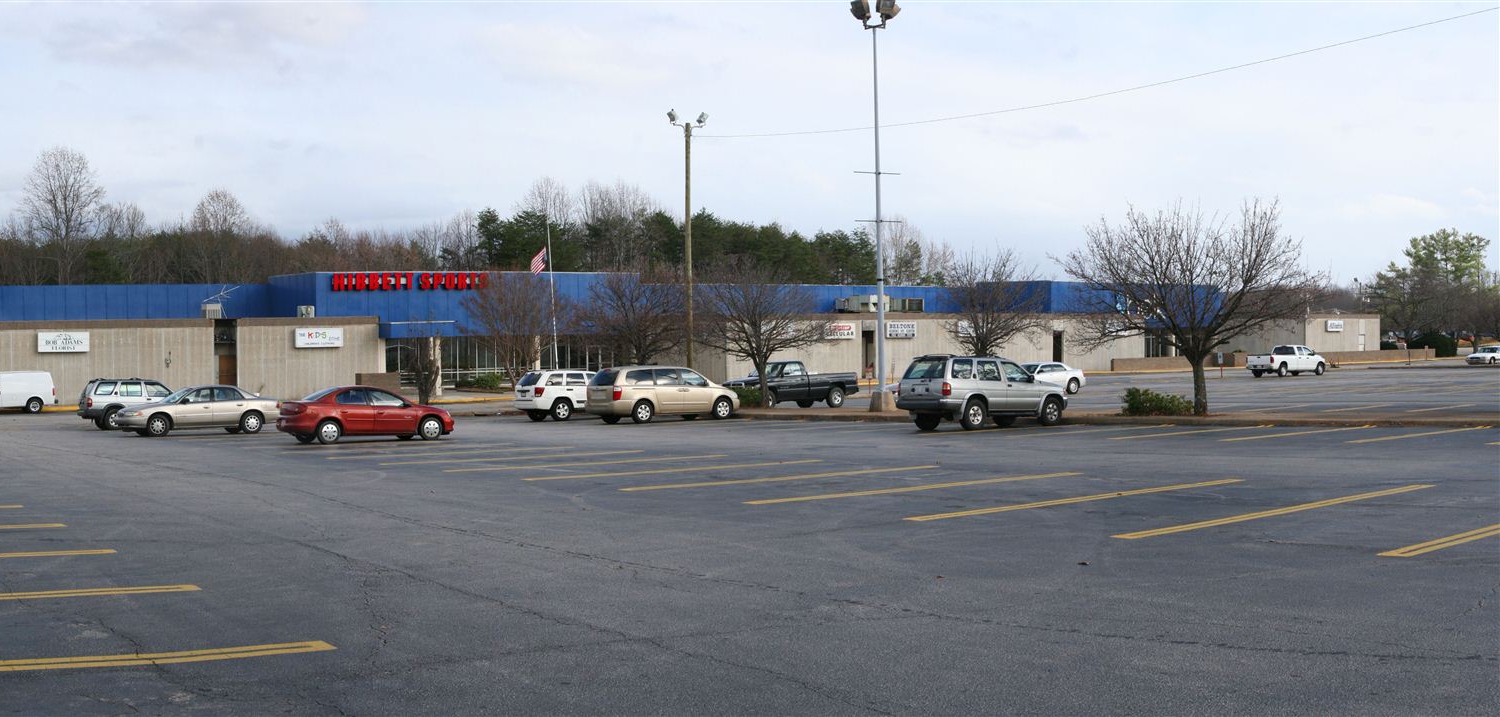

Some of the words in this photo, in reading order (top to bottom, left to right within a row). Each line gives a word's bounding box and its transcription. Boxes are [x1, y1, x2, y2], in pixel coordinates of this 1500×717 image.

[332, 273, 414, 290] HIBBETT
[420, 273, 489, 289] SPORTS
[307, 331, 327, 339] KDS
